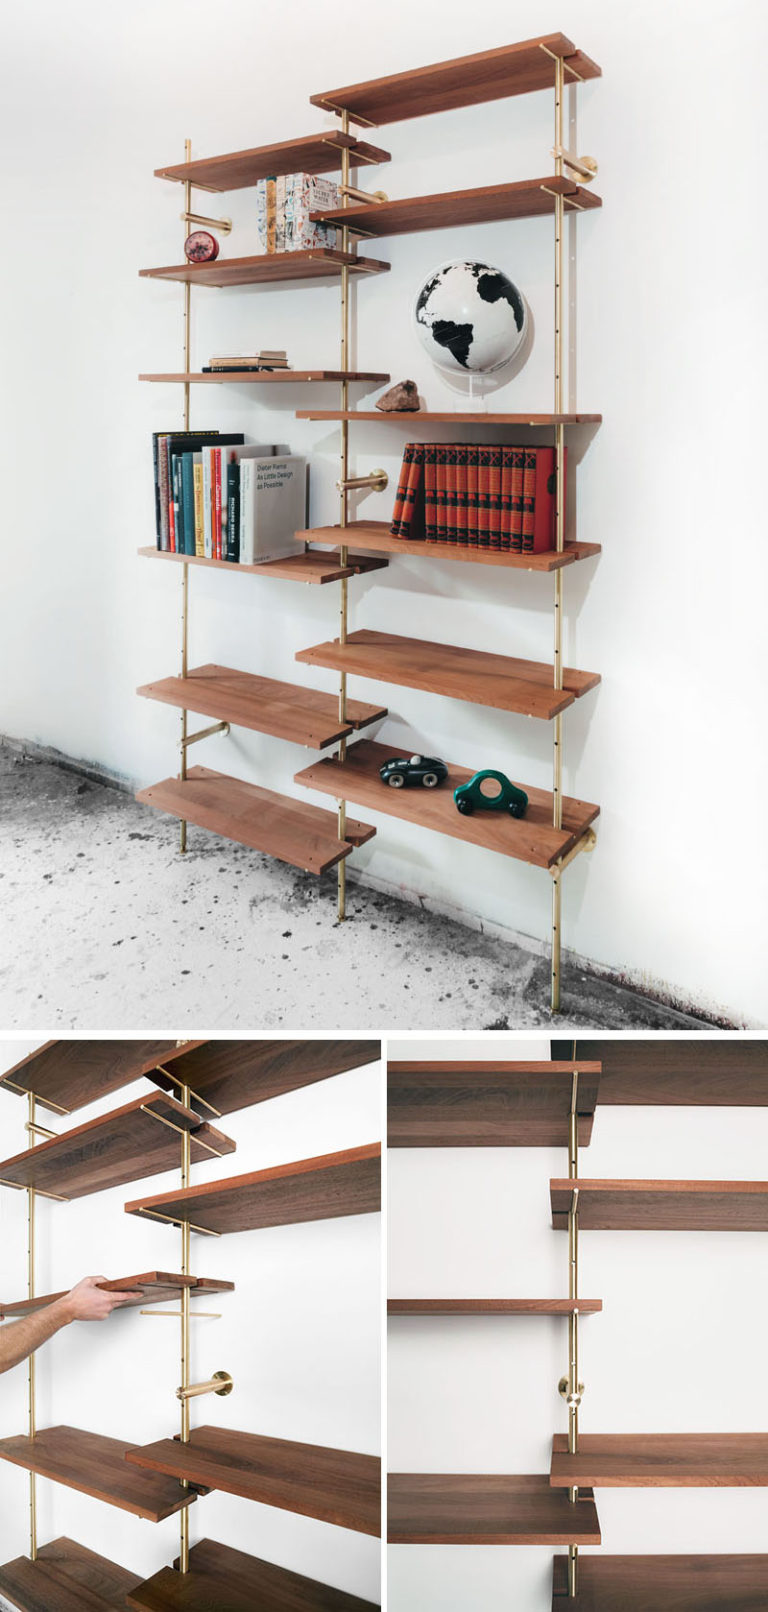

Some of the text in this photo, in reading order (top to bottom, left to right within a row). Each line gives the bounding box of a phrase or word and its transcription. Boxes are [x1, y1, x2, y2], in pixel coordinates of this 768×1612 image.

[257, 464, 271, 472] Dieter
[277, 471, 293, 479] Design
[263, 481, 283, 489] Possible
